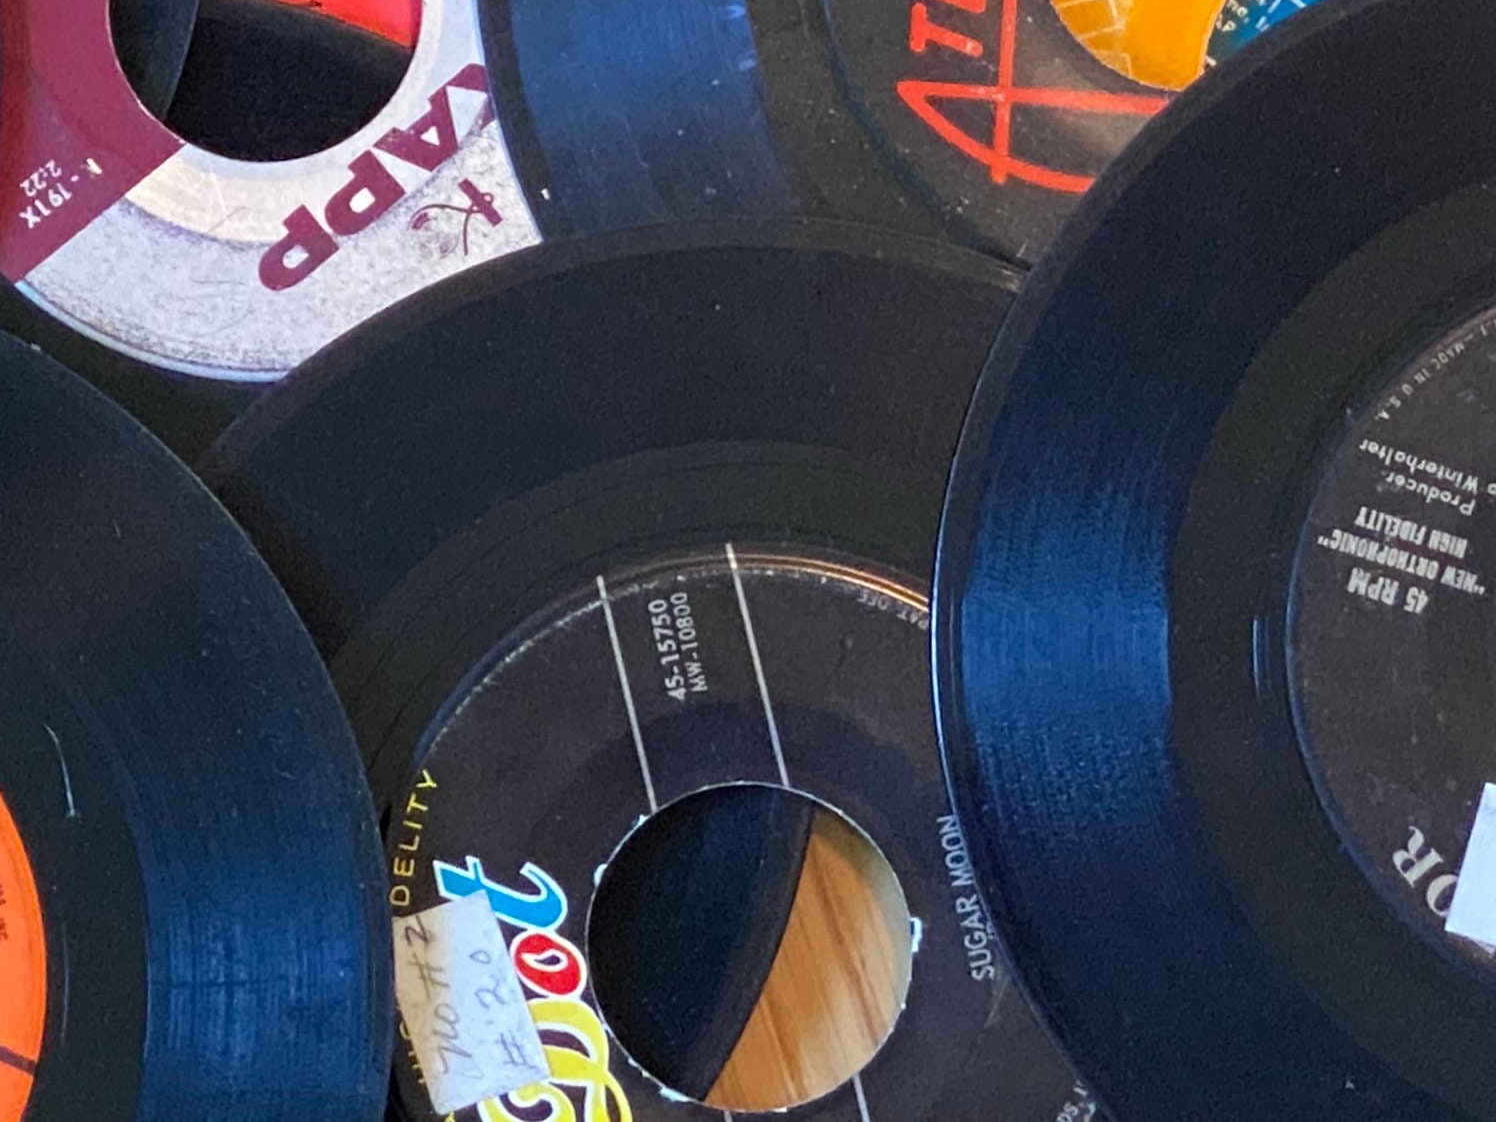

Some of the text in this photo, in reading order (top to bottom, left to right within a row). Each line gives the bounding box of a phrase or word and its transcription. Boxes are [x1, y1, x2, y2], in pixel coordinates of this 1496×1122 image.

[19, 158, 63, 197] 2:22
[1358, 437, 1479, 496] Winterhalter
[1353, 505, 1469, 561] HIGH FIDELITY
[1346, 565, 1430, 616] 45 RPM
[647, 597, 688, 703] 45-15750
[669, 591, 709, 694] MW-10800
[389, 768, 438, 907] DELITY
[935, 813, 996, 983] SUGAR MOON
